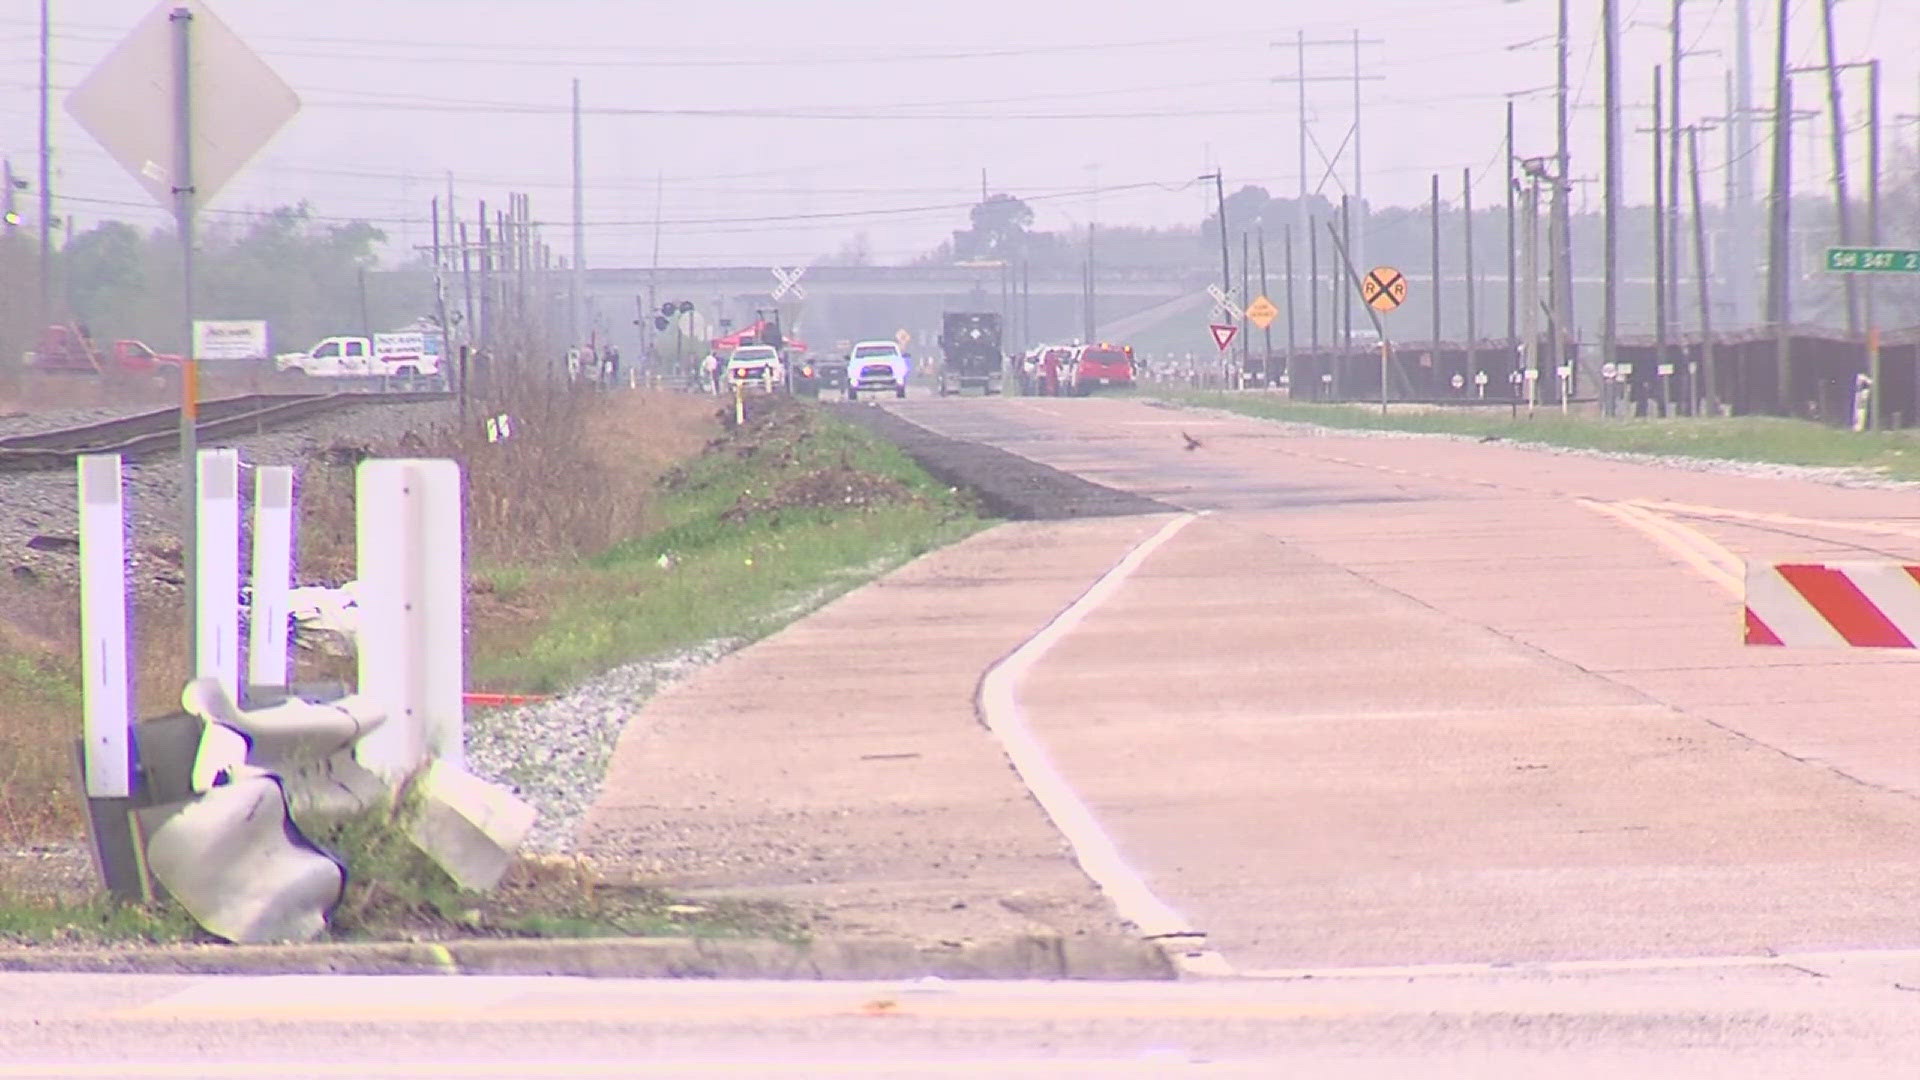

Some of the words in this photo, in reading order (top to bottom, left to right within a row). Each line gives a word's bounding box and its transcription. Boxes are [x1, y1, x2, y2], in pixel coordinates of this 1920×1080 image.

[1832, 251, 1857, 267] SH
[1861, 252, 1895, 268] 347
[1366, 282, 1375, 294] R
[1394, 284, 1404, 295] R
